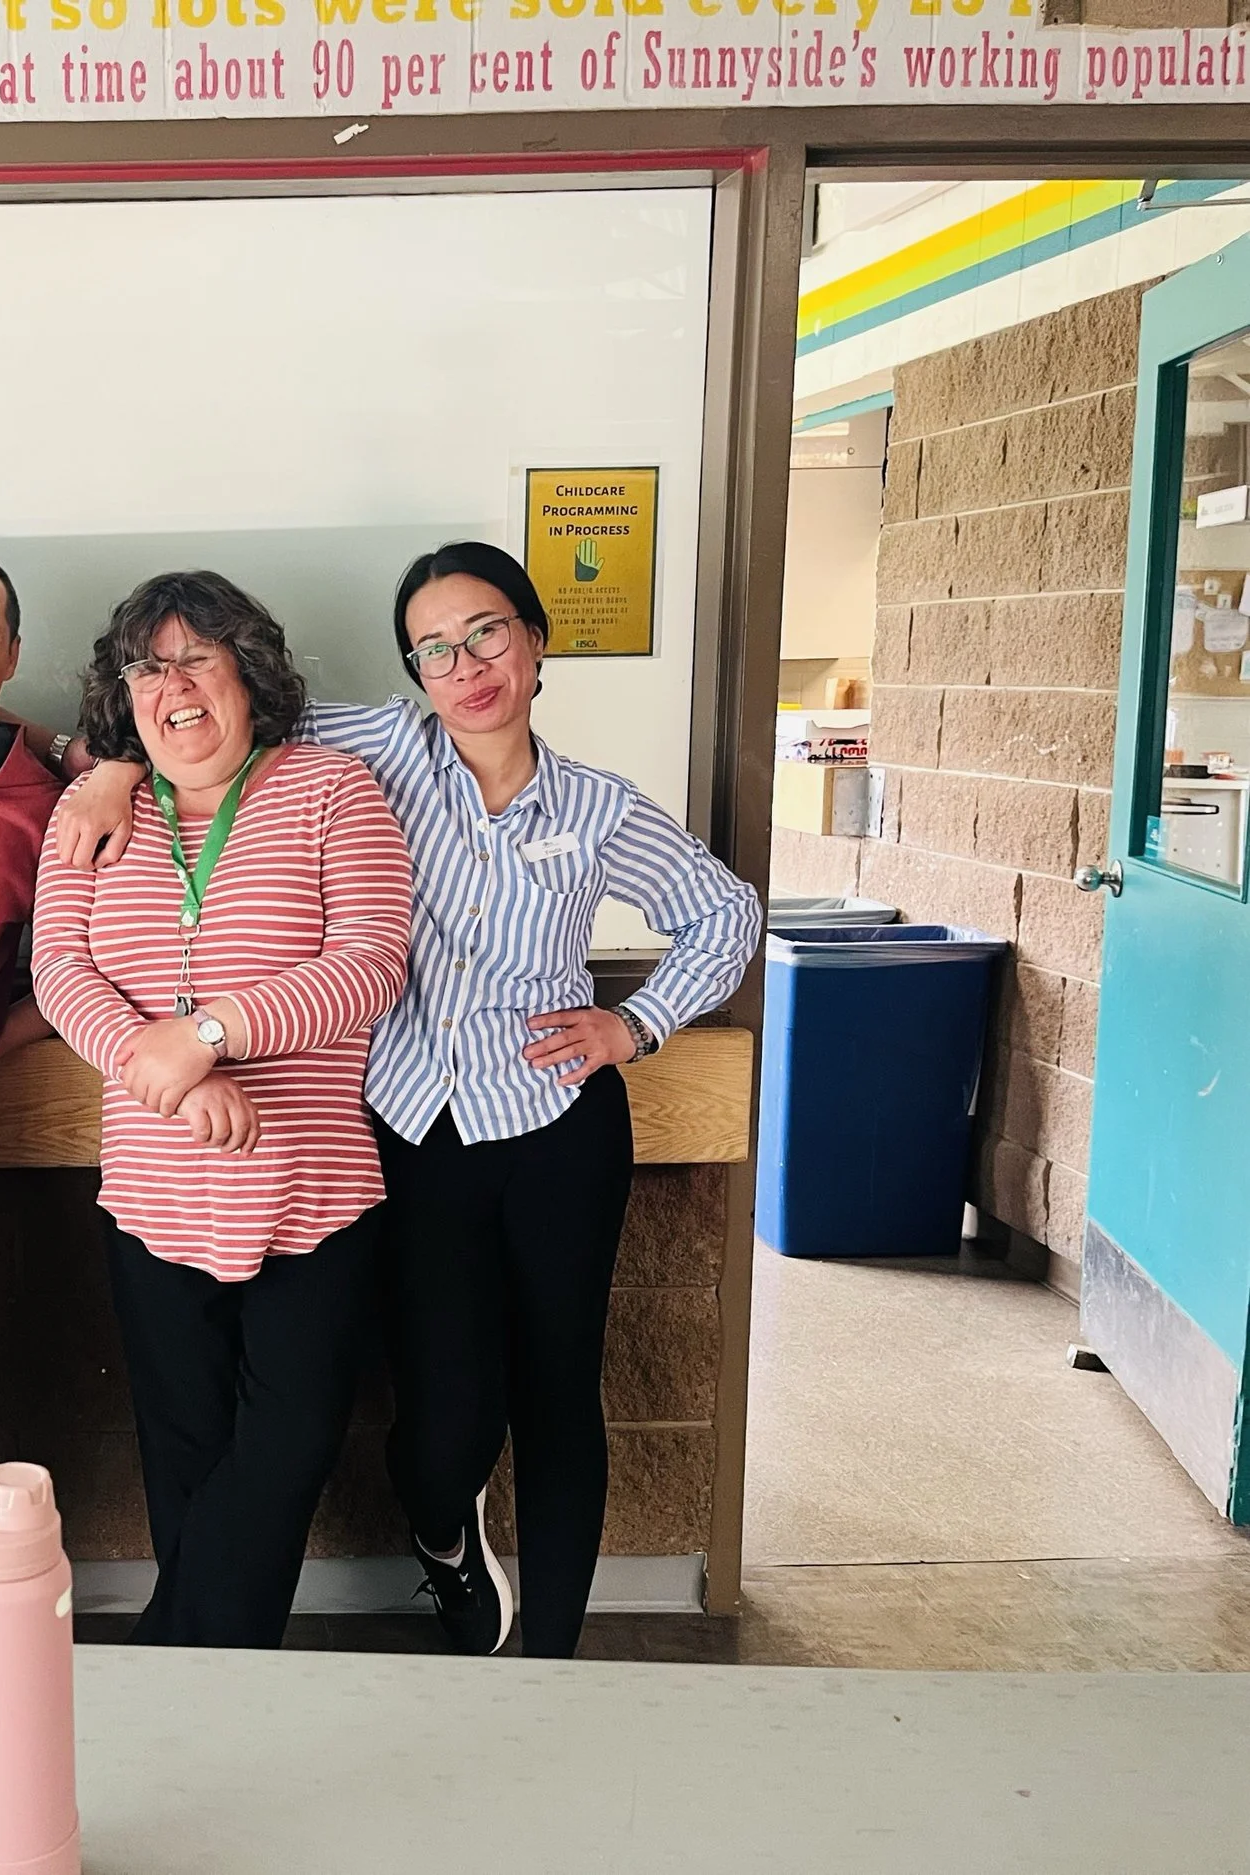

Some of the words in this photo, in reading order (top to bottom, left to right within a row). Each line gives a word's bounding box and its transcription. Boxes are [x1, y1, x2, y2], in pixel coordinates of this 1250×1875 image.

[50, 0, 128, 31] so
[62, 44, 147, 104] time
[174, 42, 285, 101] about
[313, 38, 355, 99] 90
[382, 53, 445, 110] per
[470, 38, 553, 94] cent
[580, 30, 621, 91] of
[643, 29, 877, 101] Sunnyside's
[903, 30, 1061, 100] working
[1085, 29, 1246, 100] populati
